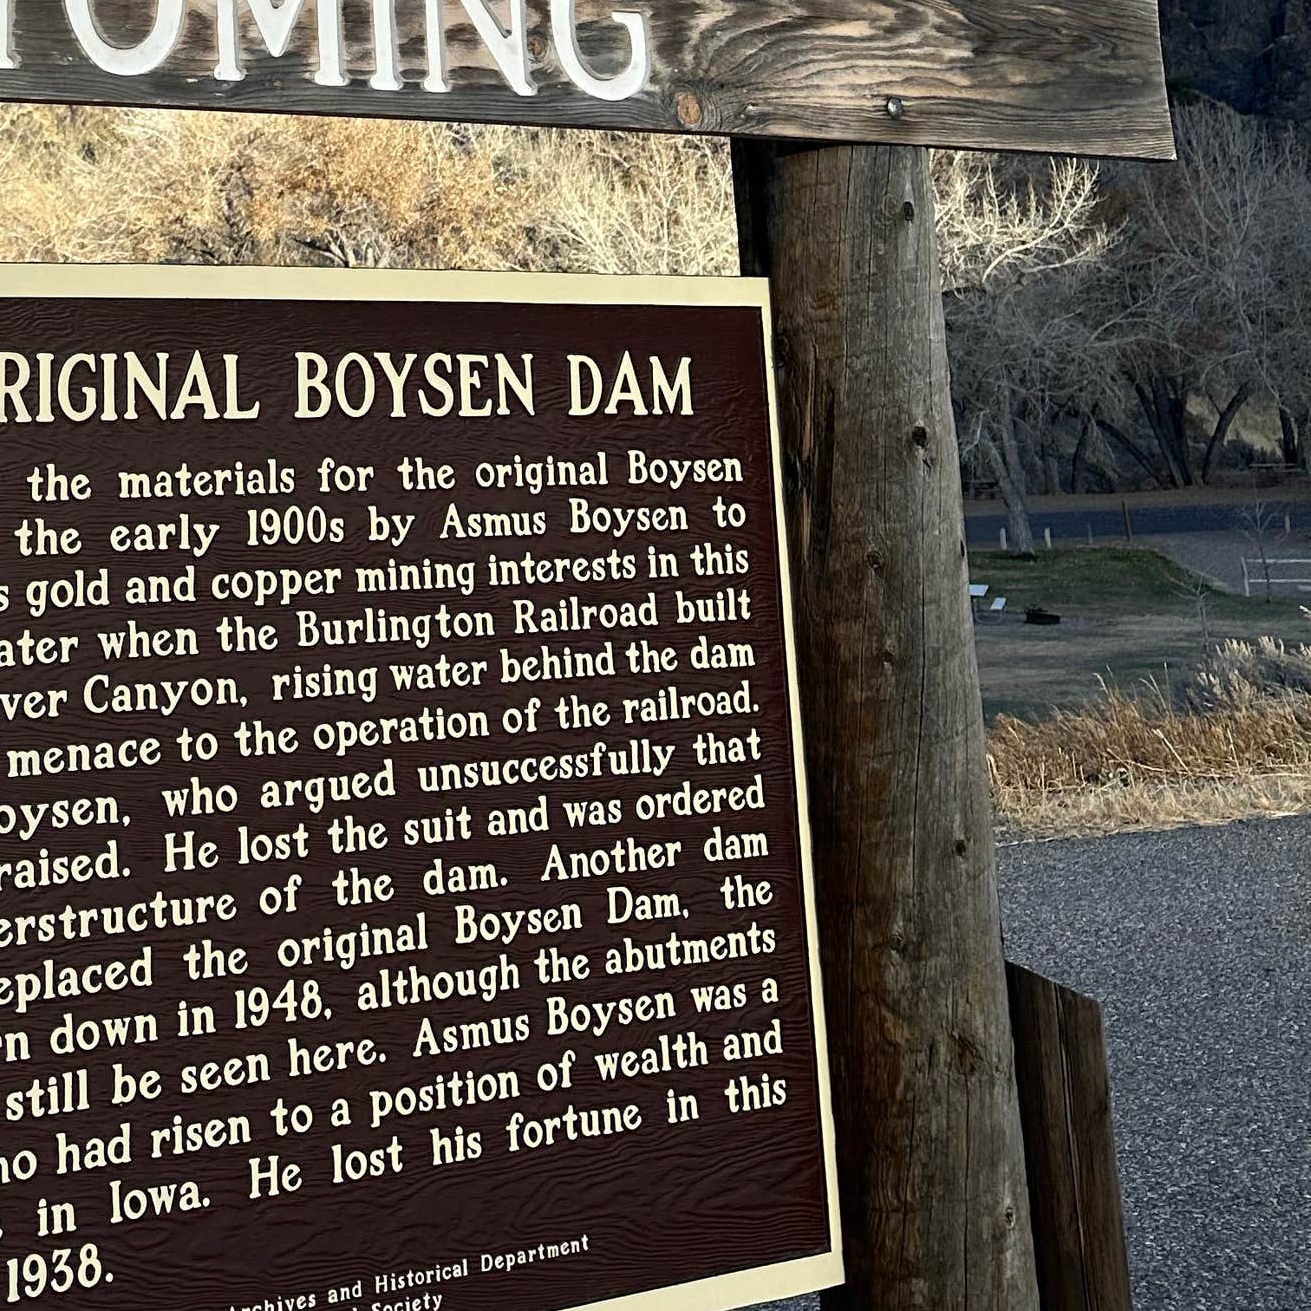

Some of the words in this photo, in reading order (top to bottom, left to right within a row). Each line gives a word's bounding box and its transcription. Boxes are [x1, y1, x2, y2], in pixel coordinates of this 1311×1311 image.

[294, 351, 536, 419] BOYSEN
[566, 350, 694, 416] DAM
[26, 463, 92, 502] the
[118, 458, 295, 499] materials
[317, 457, 374, 493] for
[396, 456, 456, 491] the
[475, 451, 609, 495] original
[627, 449, 744, 490] Boysen
[13, 517, 82, 557] the
[109, 513, 220, 558] early
[247, 505, 344, 546] 1900s
[367, 505, 416, 547] by
[439, 502, 547, 539] Asmus
[568, 497, 689, 538] Boysen
[711, 495, 746, 528] to
[25, 568, 110, 618] gold
[125, 565, 197, 604] and
[211, 568, 342, 606] copper
[354, 558, 476, 596] mining
[488, 548, 637, 586] interests
[689, 542, 749, 576] this
[97, 620, 199, 660] when
[215, 615, 279, 652] the
[295, 604, 495, 649] Burlington
[512, 592, 659, 634] Railroad
[675, 587, 751, 624] built
[83, 674, 248, 716] Canyon,
[271, 663, 378, 703] rising
[388, 654, 488, 691] water
[499, 641, 616, 683] behind
[624, 640, 678, 674] the
[690, 635, 756, 670] dam
[6, 737, 162, 778] menace
[175, 727, 218, 762] to
[233, 720, 299, 757] the
[313, 706, 490, 757] operation
[502, 697, 541, 734] of
[553, 694, 611, 730] the
[622, 679, 760, 724] railroad.
[161, 776, 238, 817] who
[260, 758, 396, 814] argued
[417, 738, 676, 792] unsuccessfully
[692, 727, 762, 766] that
[164, 830, 219, 873] He
[237, 822, 309, 865] lost
[327, 815, 389, 854] the
[404, 805, 472, 846] suit
[487, 795, 550, 836] and
[562, 799, 623, 828] was
[635, 773, 766, 820] ordered
[259, 874, 303, 915] of
[331, 867, 395, 906] the
[423, 858, 508, 896] dam.
[540, 837, 682, 882] Another
[703, 825, 769, 862] dam
[182, 939, 249, 981] the
[277, 911, 429, 970] original
[454, 903, 583, 945] Boysen
[606, 886, 689, 924] Dam,
[719, 874, 774, 910] the
[49, 1012, 159, 1055] down
[177, 1000, 217, 1037] in
[234, 979, 332, 1029] 1948,
[357, 953, 520, 1011] although
[533, 947, 591, 984] the
[605, 921, 776, 975] abutments
[6, 1068, 90, 1121] still
[111, 1063, 162, 1104] be
[181, 1053, 271, 1094] seen
[287, 1037, 387, 1077] here.
[412, 1014, 530, 1058] Asmus
[546, 992, 677, 1037] Boysen
[690, 983, 747, 1013] was
[55, 1122, 132, 1175] had
[150, 1115, 252, 1159] risen
[269, 1098, 313, 1137] to
[368, 1070, 521, 1128] position
[537, 1049, 576, 1092] of
[594, 1031, 709, 1081] wealth
[723, 1018, 784, 1061] and
[36, 1198, 77, 1237] in
[109, 1180, 211, 1224] Iowa.
[248, 1155, 303, 1199] He
[331, 1135, 403, 1184] lost
[429, 1125, 482, 1166] his
[505, 1104, 643, 1152] fortune
[724, 1072, 787, 1113] this
[6, 1243, 114, 1303] 1938.
[327, 1280, 363, 1304] and
[374, 1258, 469, 1294] Historical
[480, 1234, 589, 1272] Department
